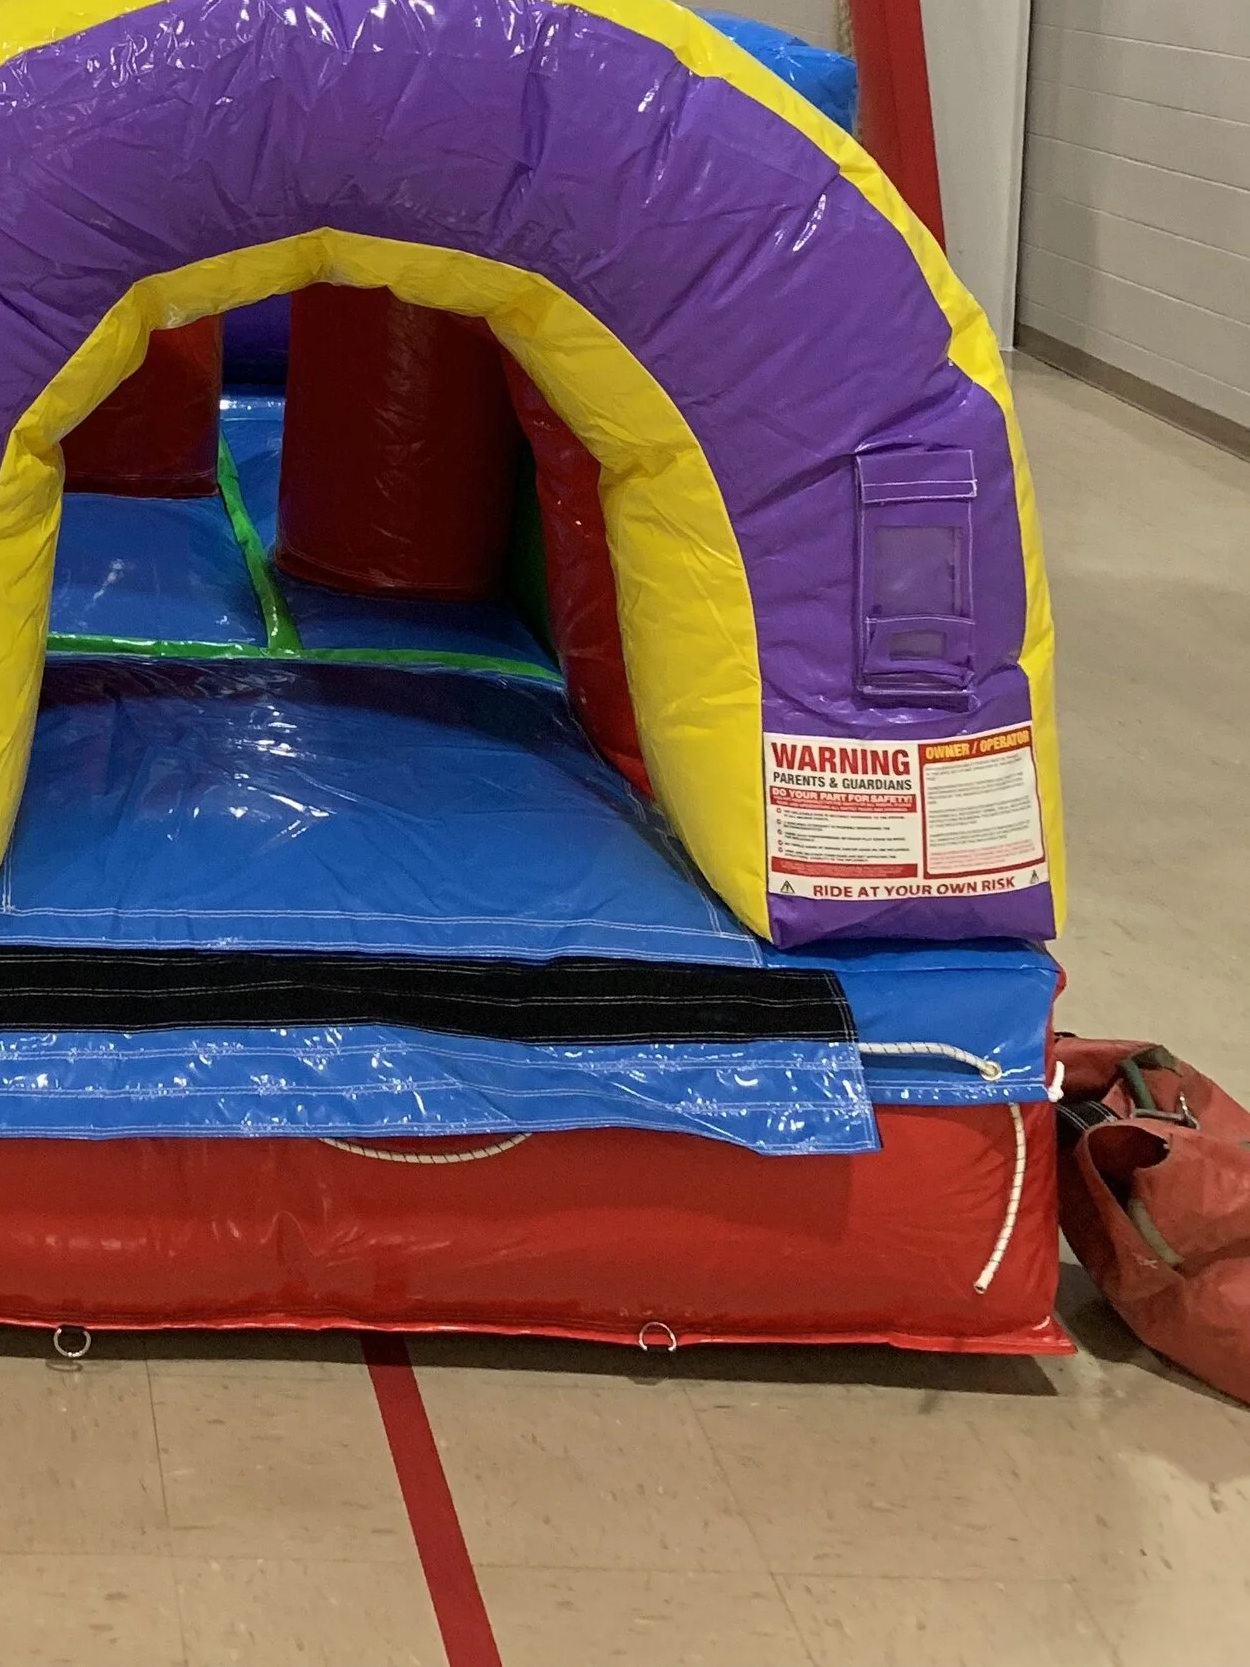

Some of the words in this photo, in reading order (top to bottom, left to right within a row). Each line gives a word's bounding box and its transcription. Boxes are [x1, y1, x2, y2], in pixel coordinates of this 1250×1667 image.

[925, 743, 970, 760] OWNER
[971, 741, 979, 754] /
[979, 730, 1030, 753] OPERATOR
[771, 742, 911, 776] WARNING
[773, 771, 826, 788] PARENTS
[829, 777, 838, 788] &
[842, 778, 912, 790] GUARDIANS
[772, 787, 787, 796] DO
[788, 789, 819, 800] YOUR
[820, 792, 847, 802] PART
[848, 794, 869, 802] FOR
[869, 794, 913, 803] SAFETY!
[813, 885, 853, 898] RIDE
[857, 886, 880, 898] AT
[885, 884, 932, 897] YOUR
[937, 882, 977, 894] OWN
[982, 876, 1016, 892] RISK
